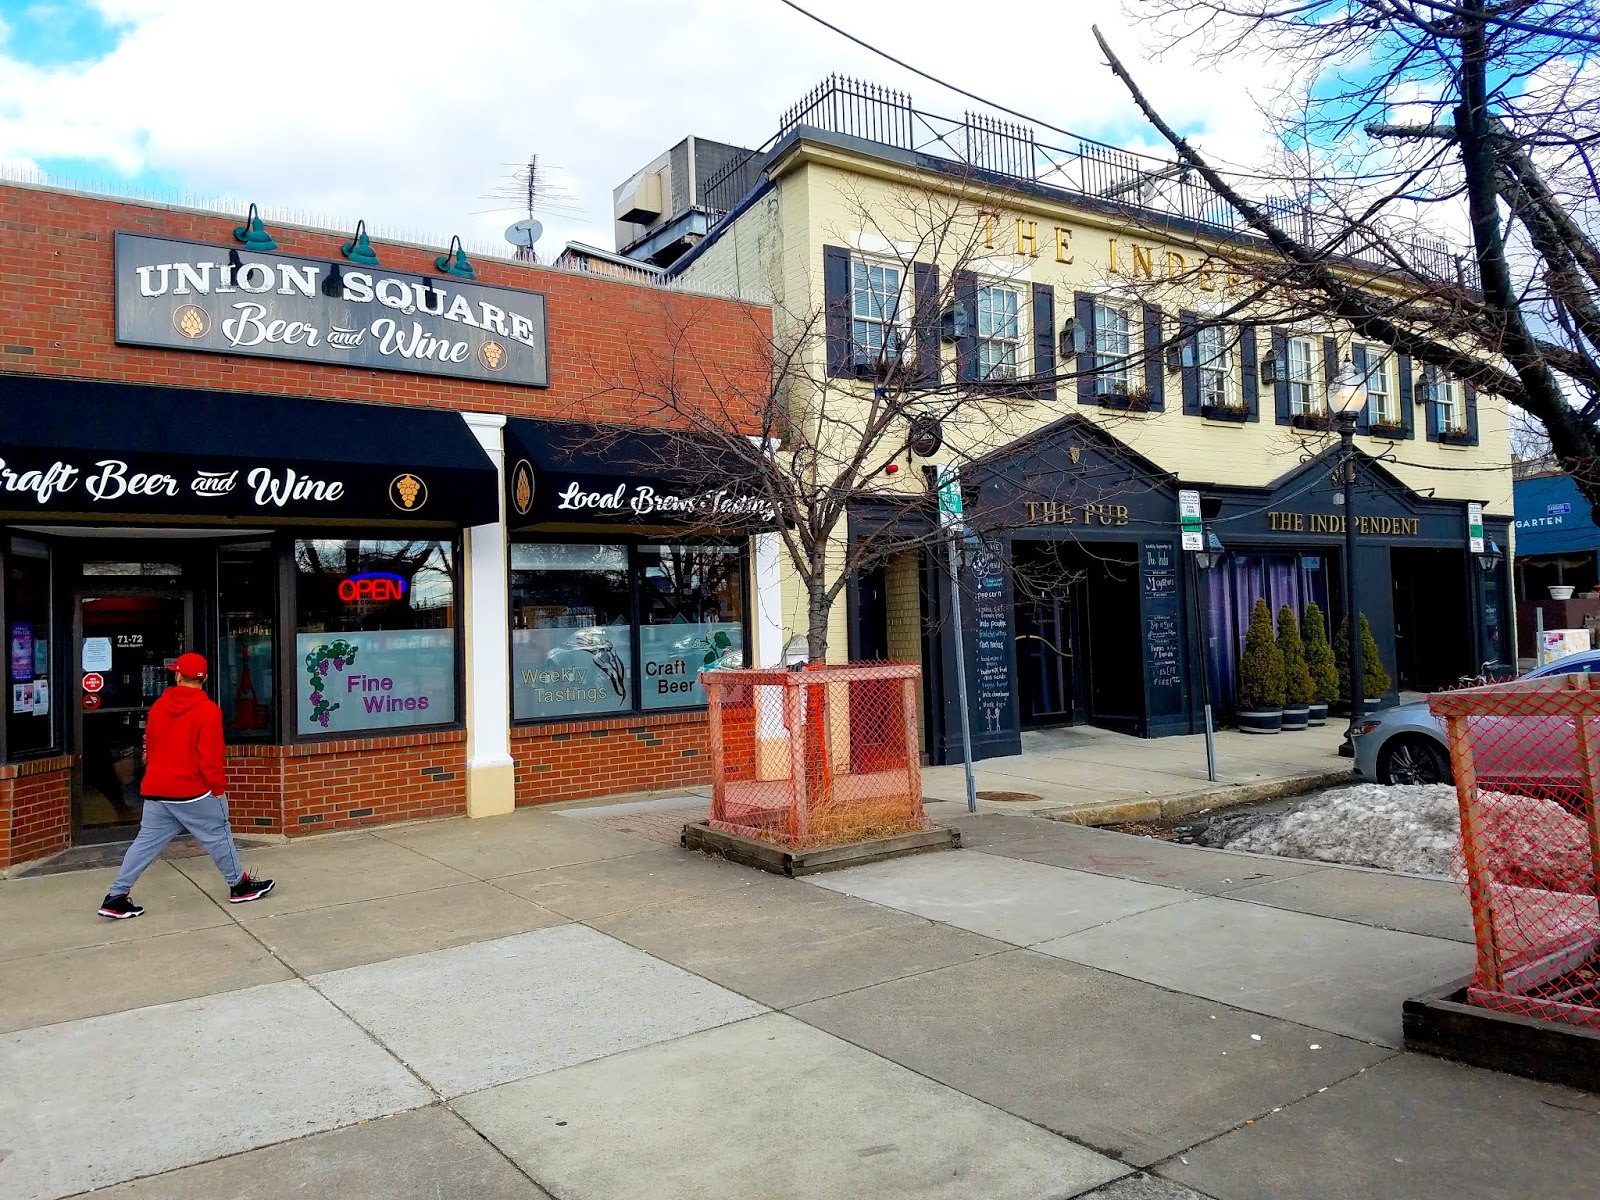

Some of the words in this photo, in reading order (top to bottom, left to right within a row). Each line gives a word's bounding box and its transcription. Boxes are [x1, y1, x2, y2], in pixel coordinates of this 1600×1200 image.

[977, 209, 1075, 265] THE
[136, 261, 320, 300] UNION
[342, 271, 534, 348] SQUARE
[222, 301, 322, 348] Beer
[326, 325, 365, 350] and
[371, 318, 471, 363] Wine
[85, 459, 180, 502] Beer
[190, 470, 240, 497] and
[247, 467, 345, 507] Wine
[558, 482, 626, 510] Local
[631, 485, 696, 516] Brews
[1023, 501, 1077, 526] THE
[1083, 503, 1129, 527] PUB
[1267, 511, 1304, 532] THE
[1515, 515, 1563, 528] GARTEN
[338, 579, 402, 601] OPEN
[117, 635, 143, 643] 71-72
[521, 666, 588, 684] Weekly
[645, 660, 686, 677] Craft
[347, 675, 393, 693] Fine
[658, 680, 695, 694] Beer
[363, 695, 429, 714] Wines
[534, 686, 607, 704] Tastings
